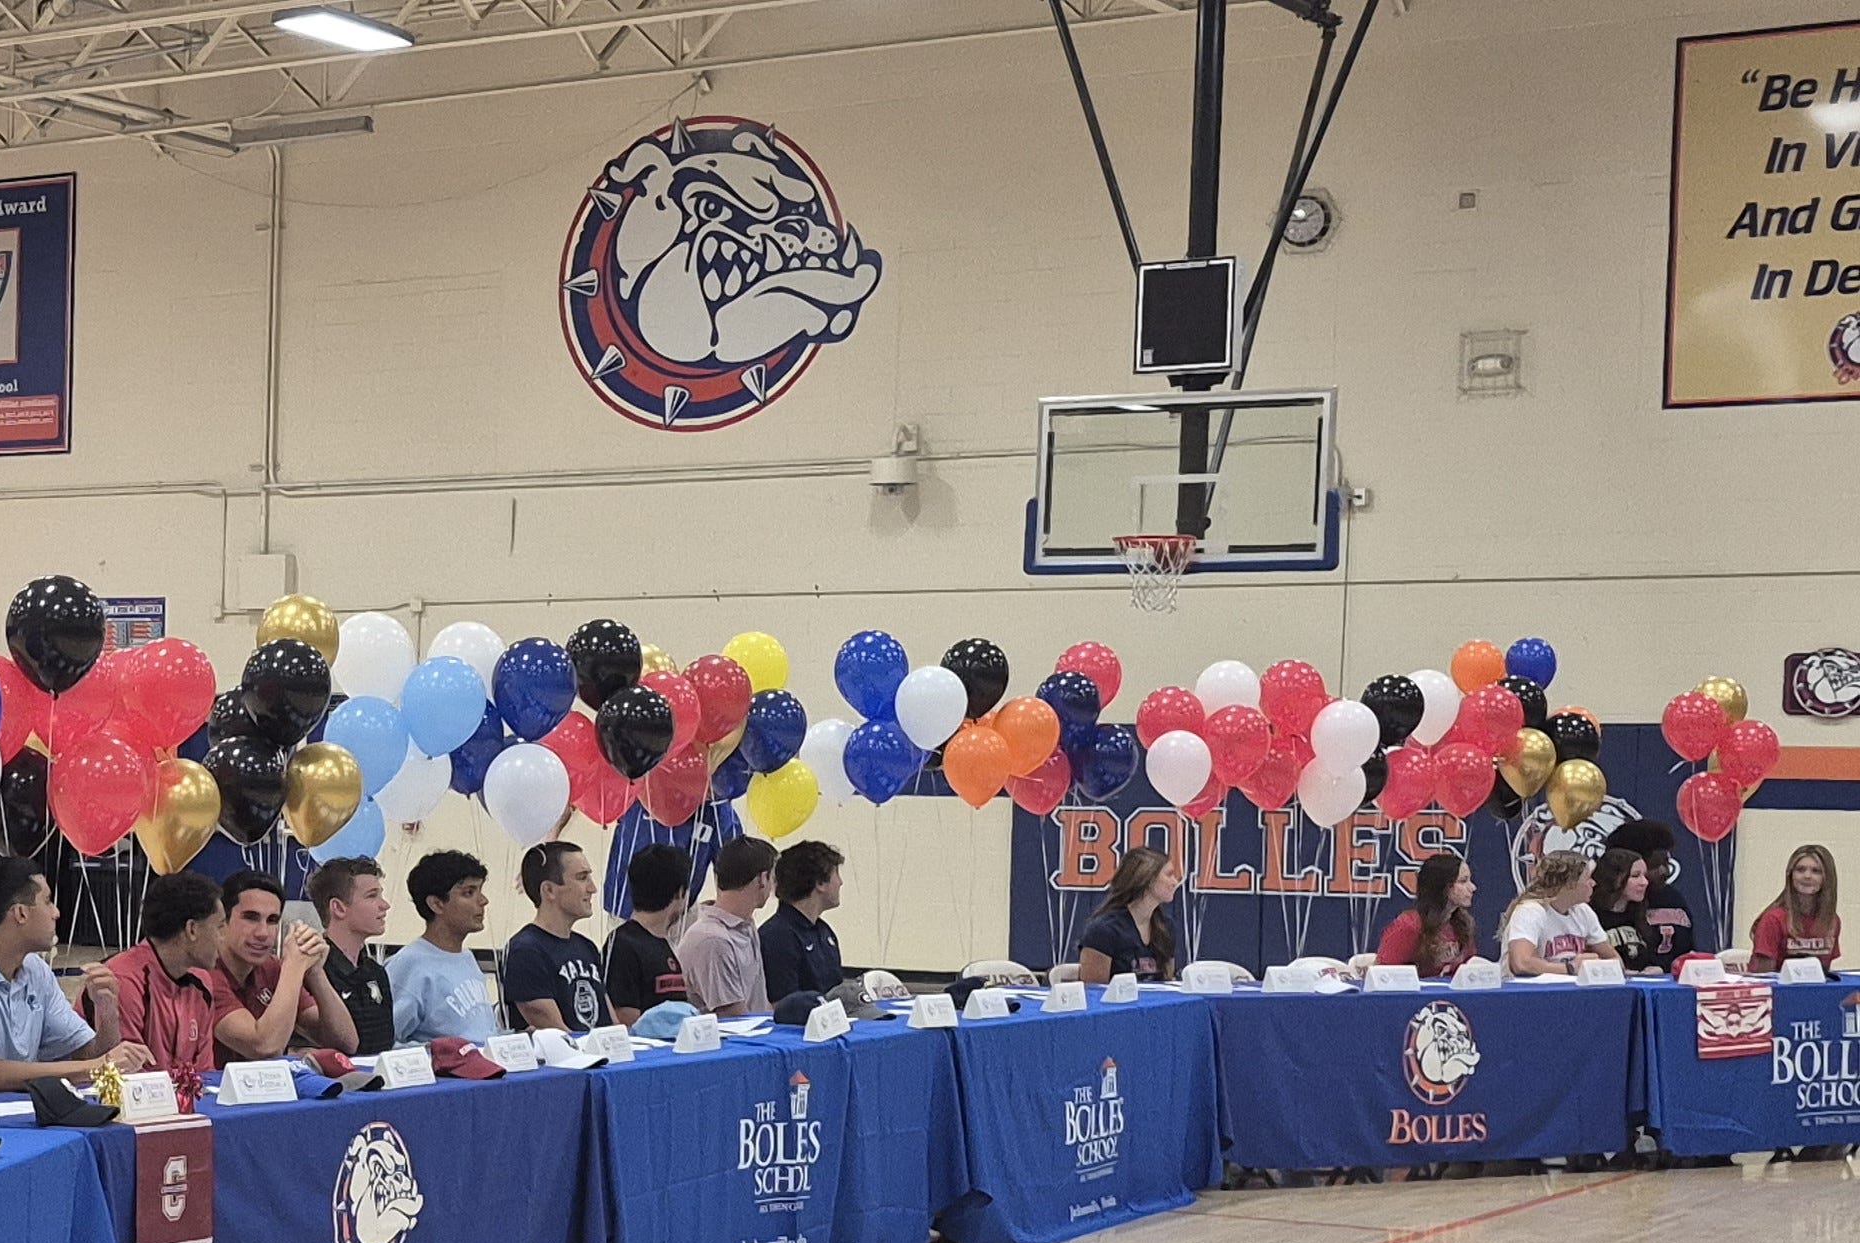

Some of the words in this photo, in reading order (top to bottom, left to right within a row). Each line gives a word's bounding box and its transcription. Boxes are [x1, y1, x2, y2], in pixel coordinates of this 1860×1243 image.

[1764, 137, 1807, 174] In
[1725, 197, 1821, 239] And
[1751, 264, 1793, 300] In
[1790, 1020, 1822, 1040] THE
[754, 1100, 776, 1122] THE
[1073, 1086, 1093, 1104] THE
[1064, 1097, 1124, 1146] BOLLES
[1388, 1108, 1488, 1145] BOLLES
